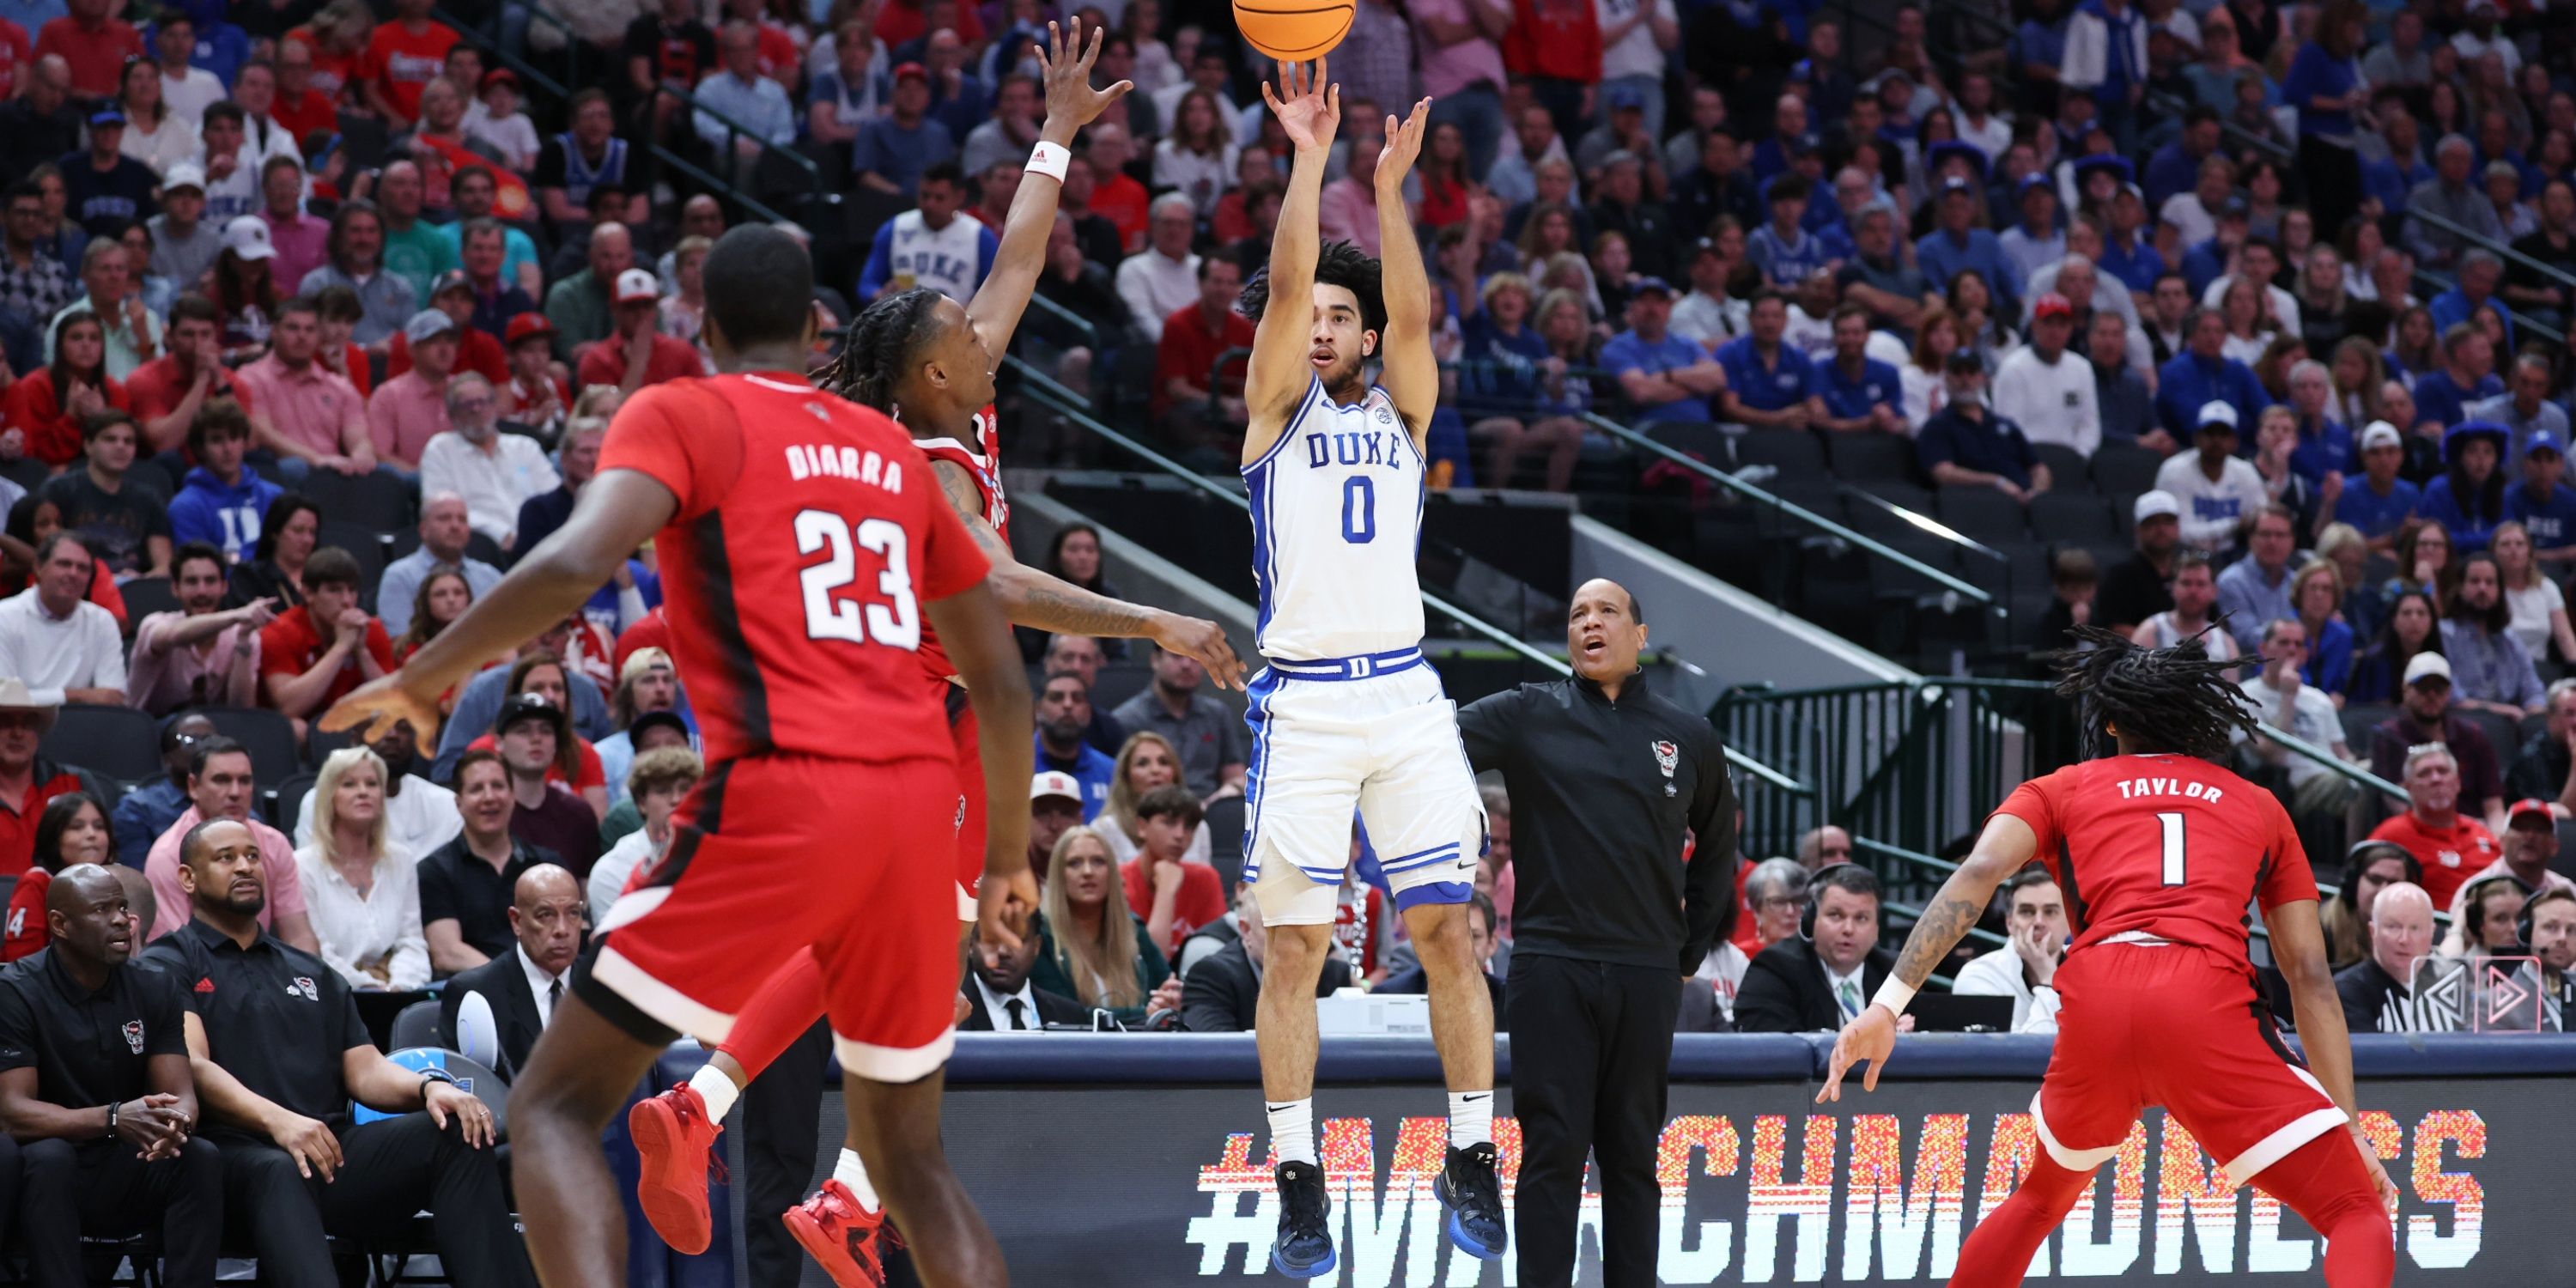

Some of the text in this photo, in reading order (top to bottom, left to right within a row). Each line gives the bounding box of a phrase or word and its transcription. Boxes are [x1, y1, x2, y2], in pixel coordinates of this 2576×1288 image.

[786, 444, 902, 495] DIARRA
[1306, 431, 1400, 470] DUKE
[1341, 475, 1376, 544] 0
[793, 509, 920, 653] 23
[1347, 656, 1370, 678] D
[2117, 778, 2223, 804] TAYLOR
[2155, 812, 2186, 887] 1
[1186, 1110, 2486, 1288] #MACHMDNS
